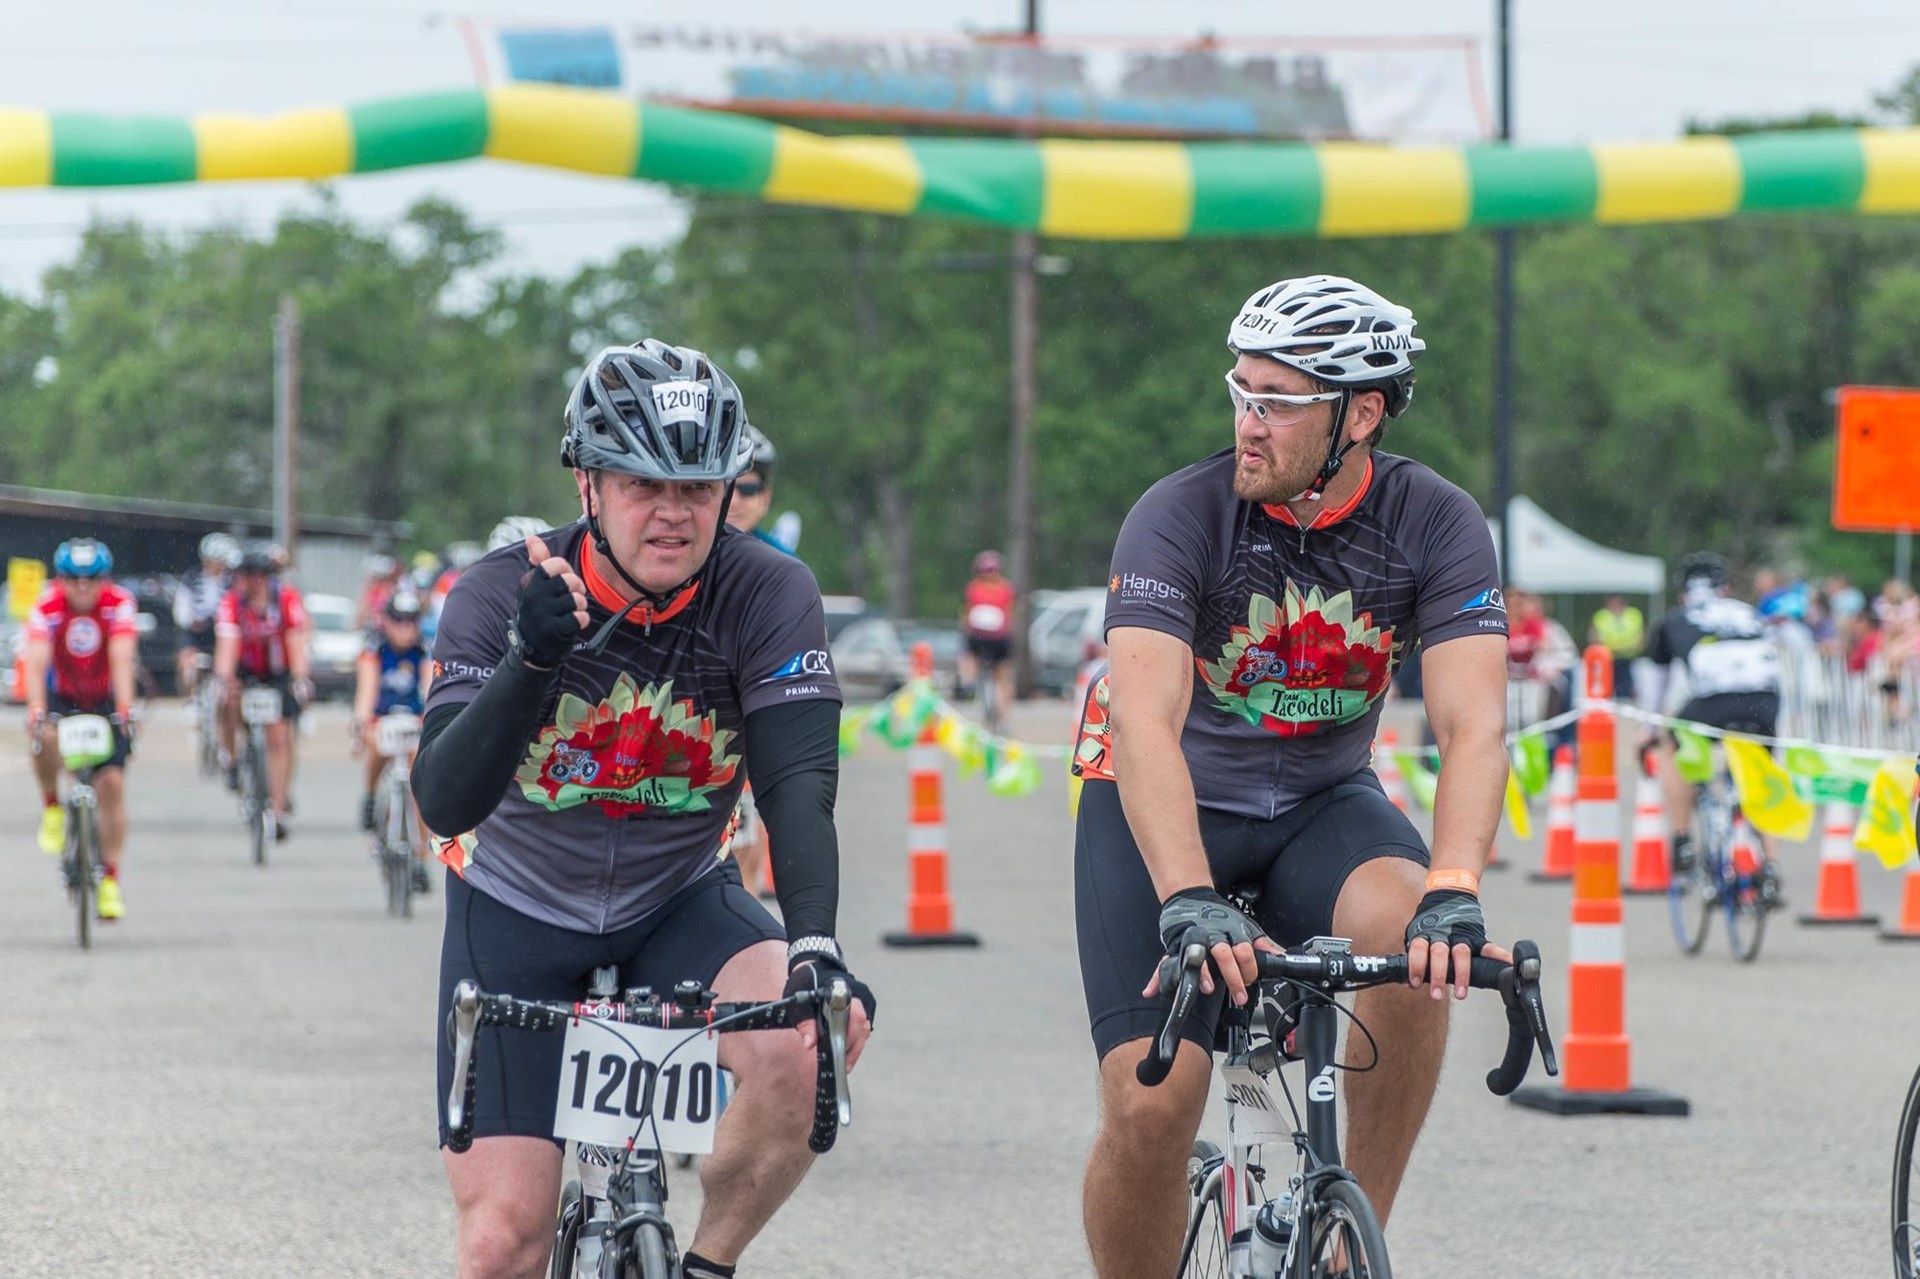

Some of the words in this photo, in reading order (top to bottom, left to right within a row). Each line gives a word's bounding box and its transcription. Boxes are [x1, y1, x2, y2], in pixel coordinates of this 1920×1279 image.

[1238, 312, 1279, 335] 12011
[1370, 335, 1412, 350] KASK
[1298, 356, 1319, 366] KASK
[656, 389, 705, 412] 12010
[1252, 544, 1273, 552] PRIM
[1121, 590, 1157, 600] CLINIC
[1478, 620, 1506, 629] PRIMAL
[444, 661, 495, 679] Hang
[785, 686, 820, 696] PRIMAL
[1270, 688, 1343, 717] Tacodeli
[1329, 960, 1344, 976] 3T
[570, 1049, 713, 1124] 12010
